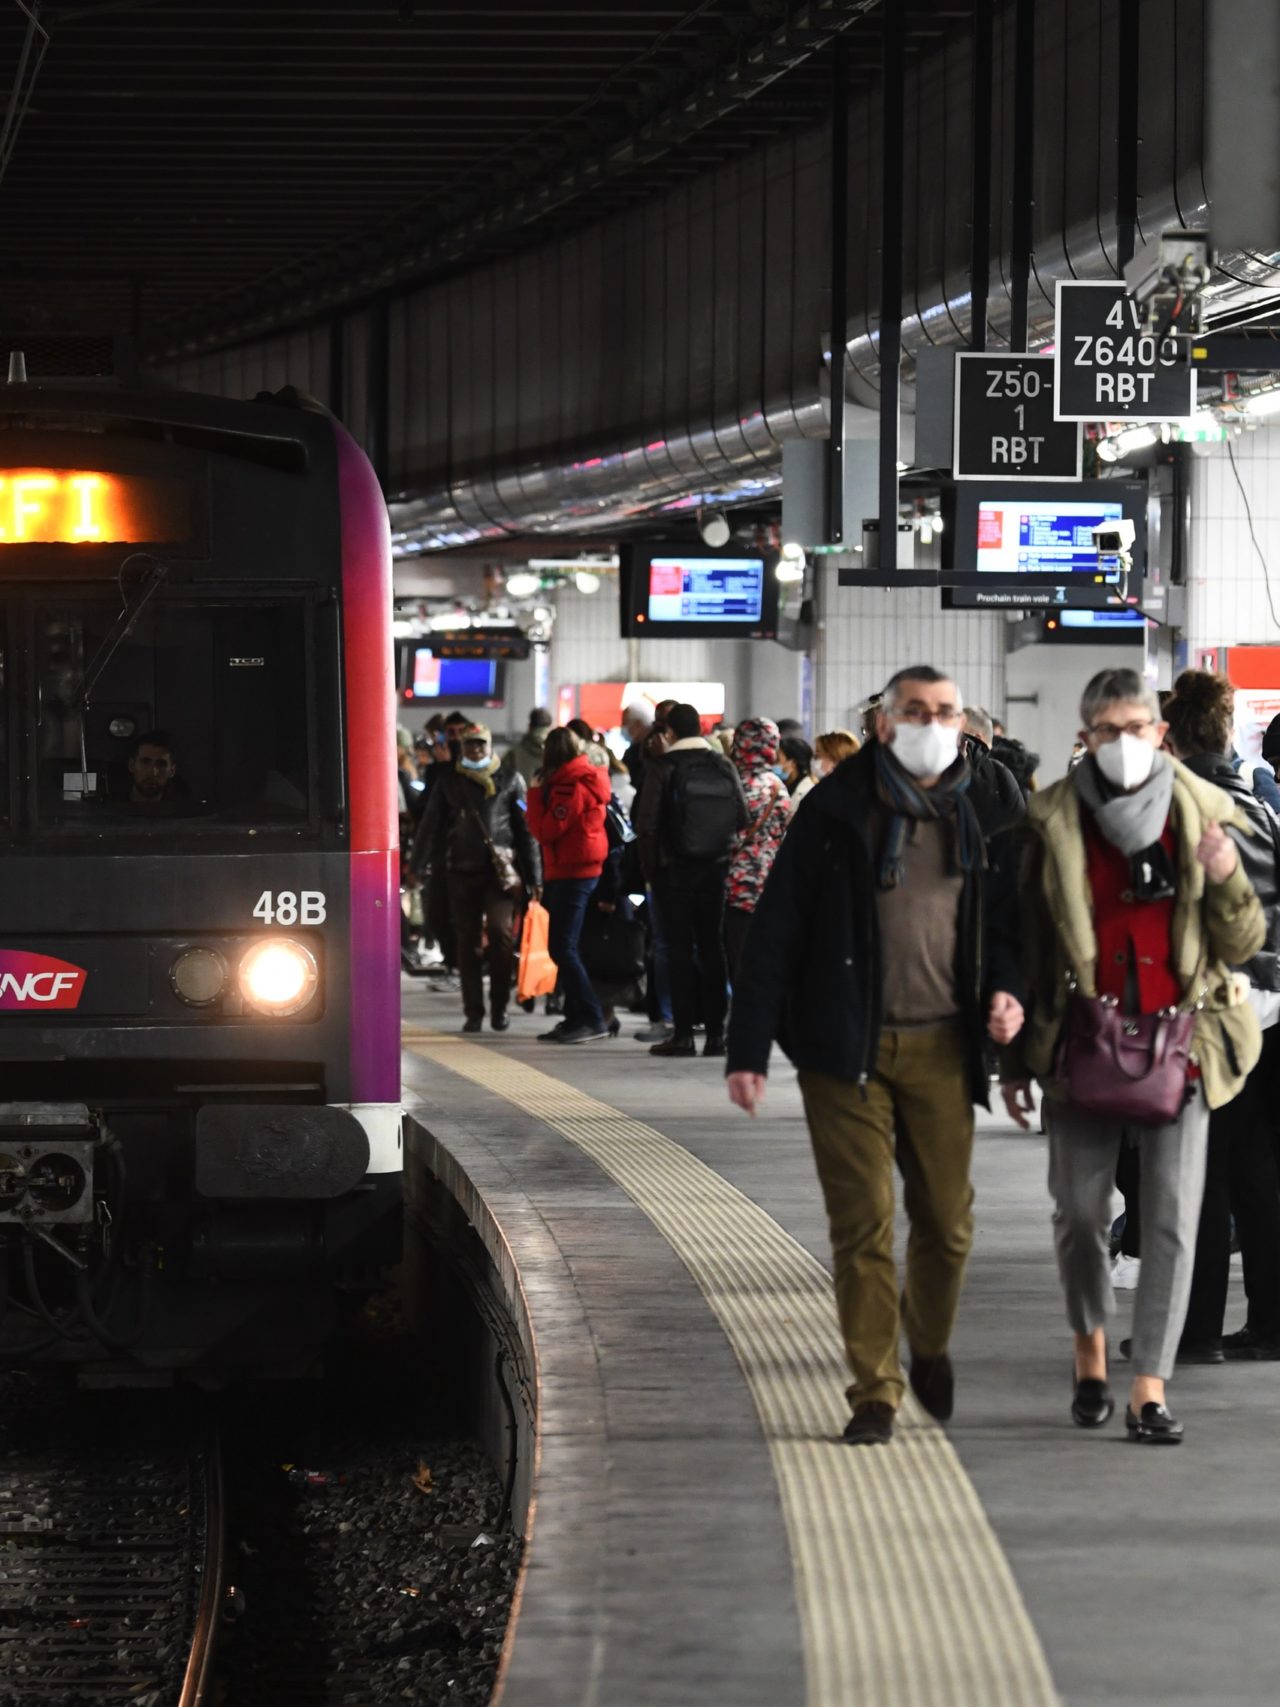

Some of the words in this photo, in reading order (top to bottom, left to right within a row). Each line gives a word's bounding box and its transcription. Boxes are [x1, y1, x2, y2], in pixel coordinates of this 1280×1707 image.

[1074, 336, 1178, 367] Z6400
[1095, 372, 1155, 403] RBT
[1014, 404, 1024, 431] 1
[991, 436, 1045, 464] RBT
[976, 593, 1011, 602] Prochain
[1012, 594, 1031, 602] train
[252, 890, 327, 926] 48B
